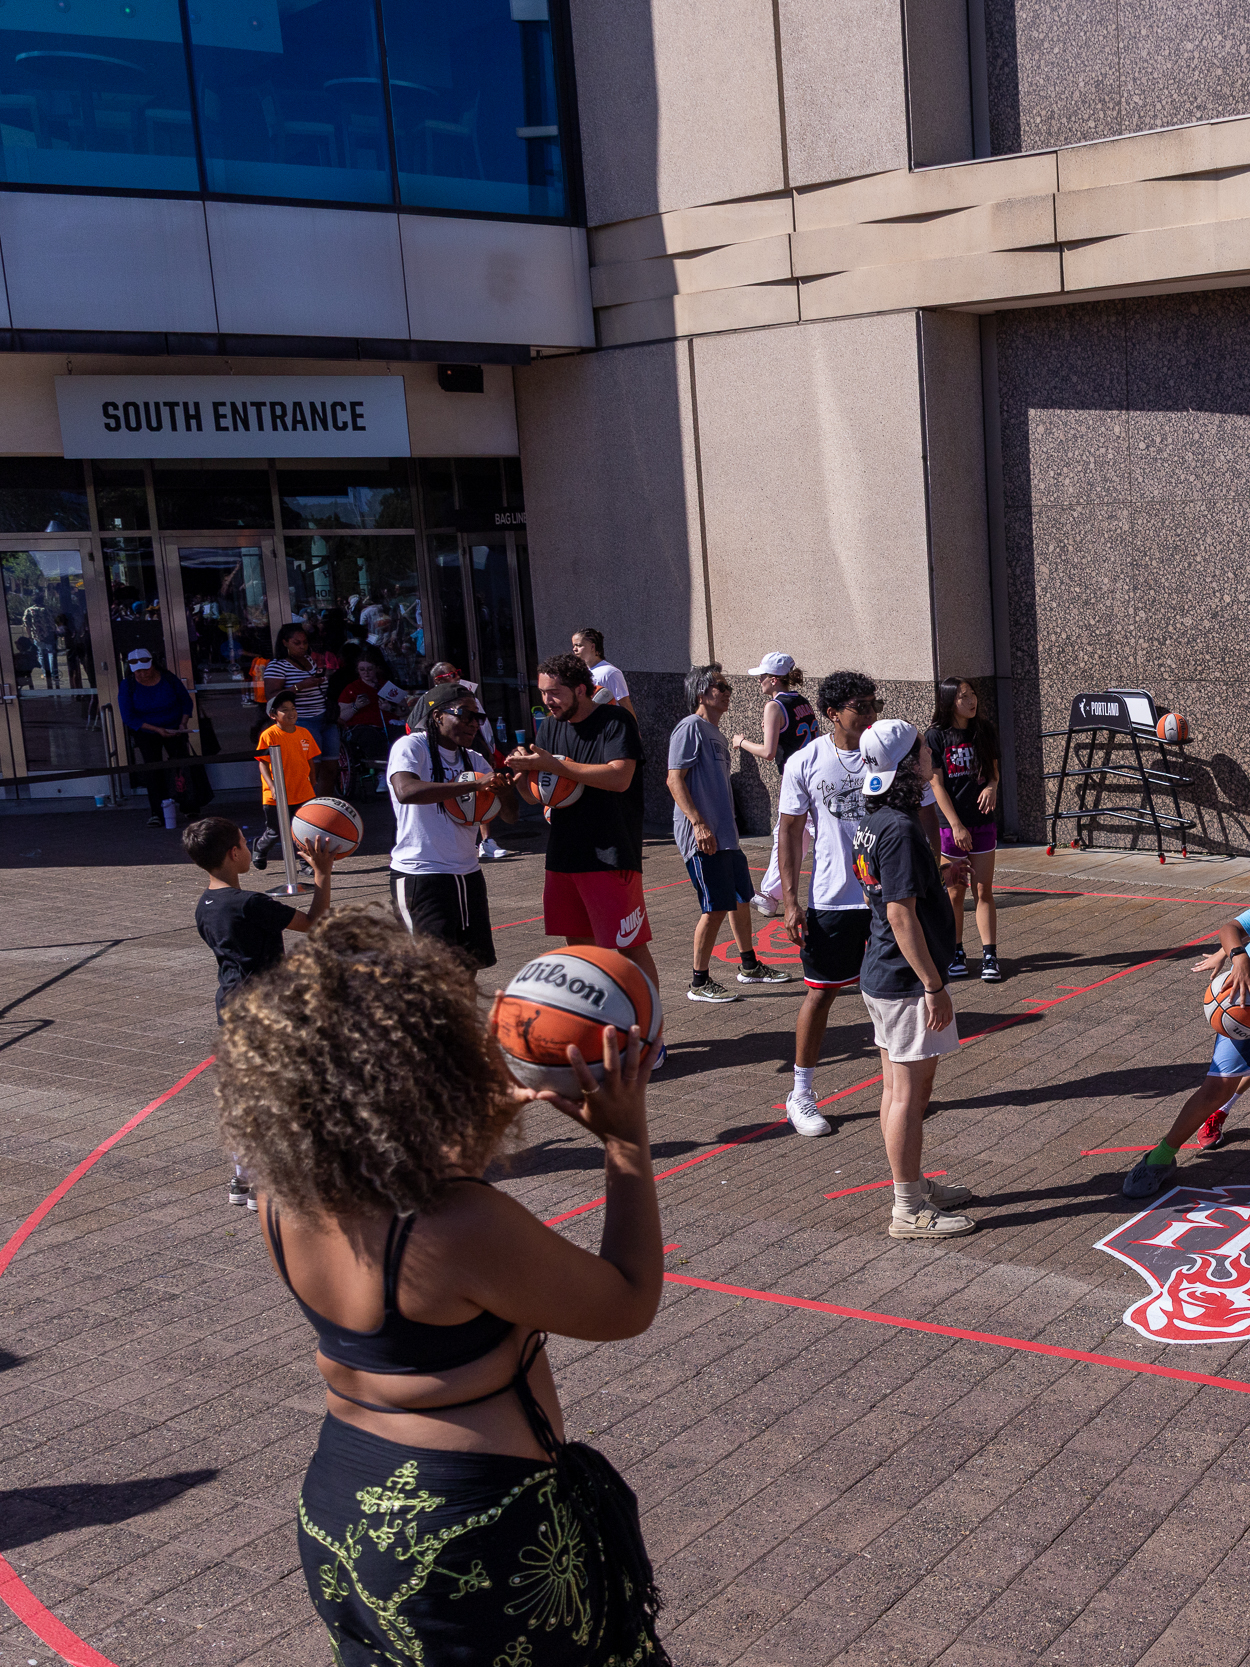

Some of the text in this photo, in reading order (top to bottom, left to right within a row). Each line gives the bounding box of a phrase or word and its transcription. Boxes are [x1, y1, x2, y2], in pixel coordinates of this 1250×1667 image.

[101, 401, 367, 432] SOUTH ENTRANCE
[494, 512, 511, 525] BAG
[1091, 701, 1119, 717] PORTLAND
[620, 906, 643, 936] NIKE
[515, 961, 609, 1011] Wilson
